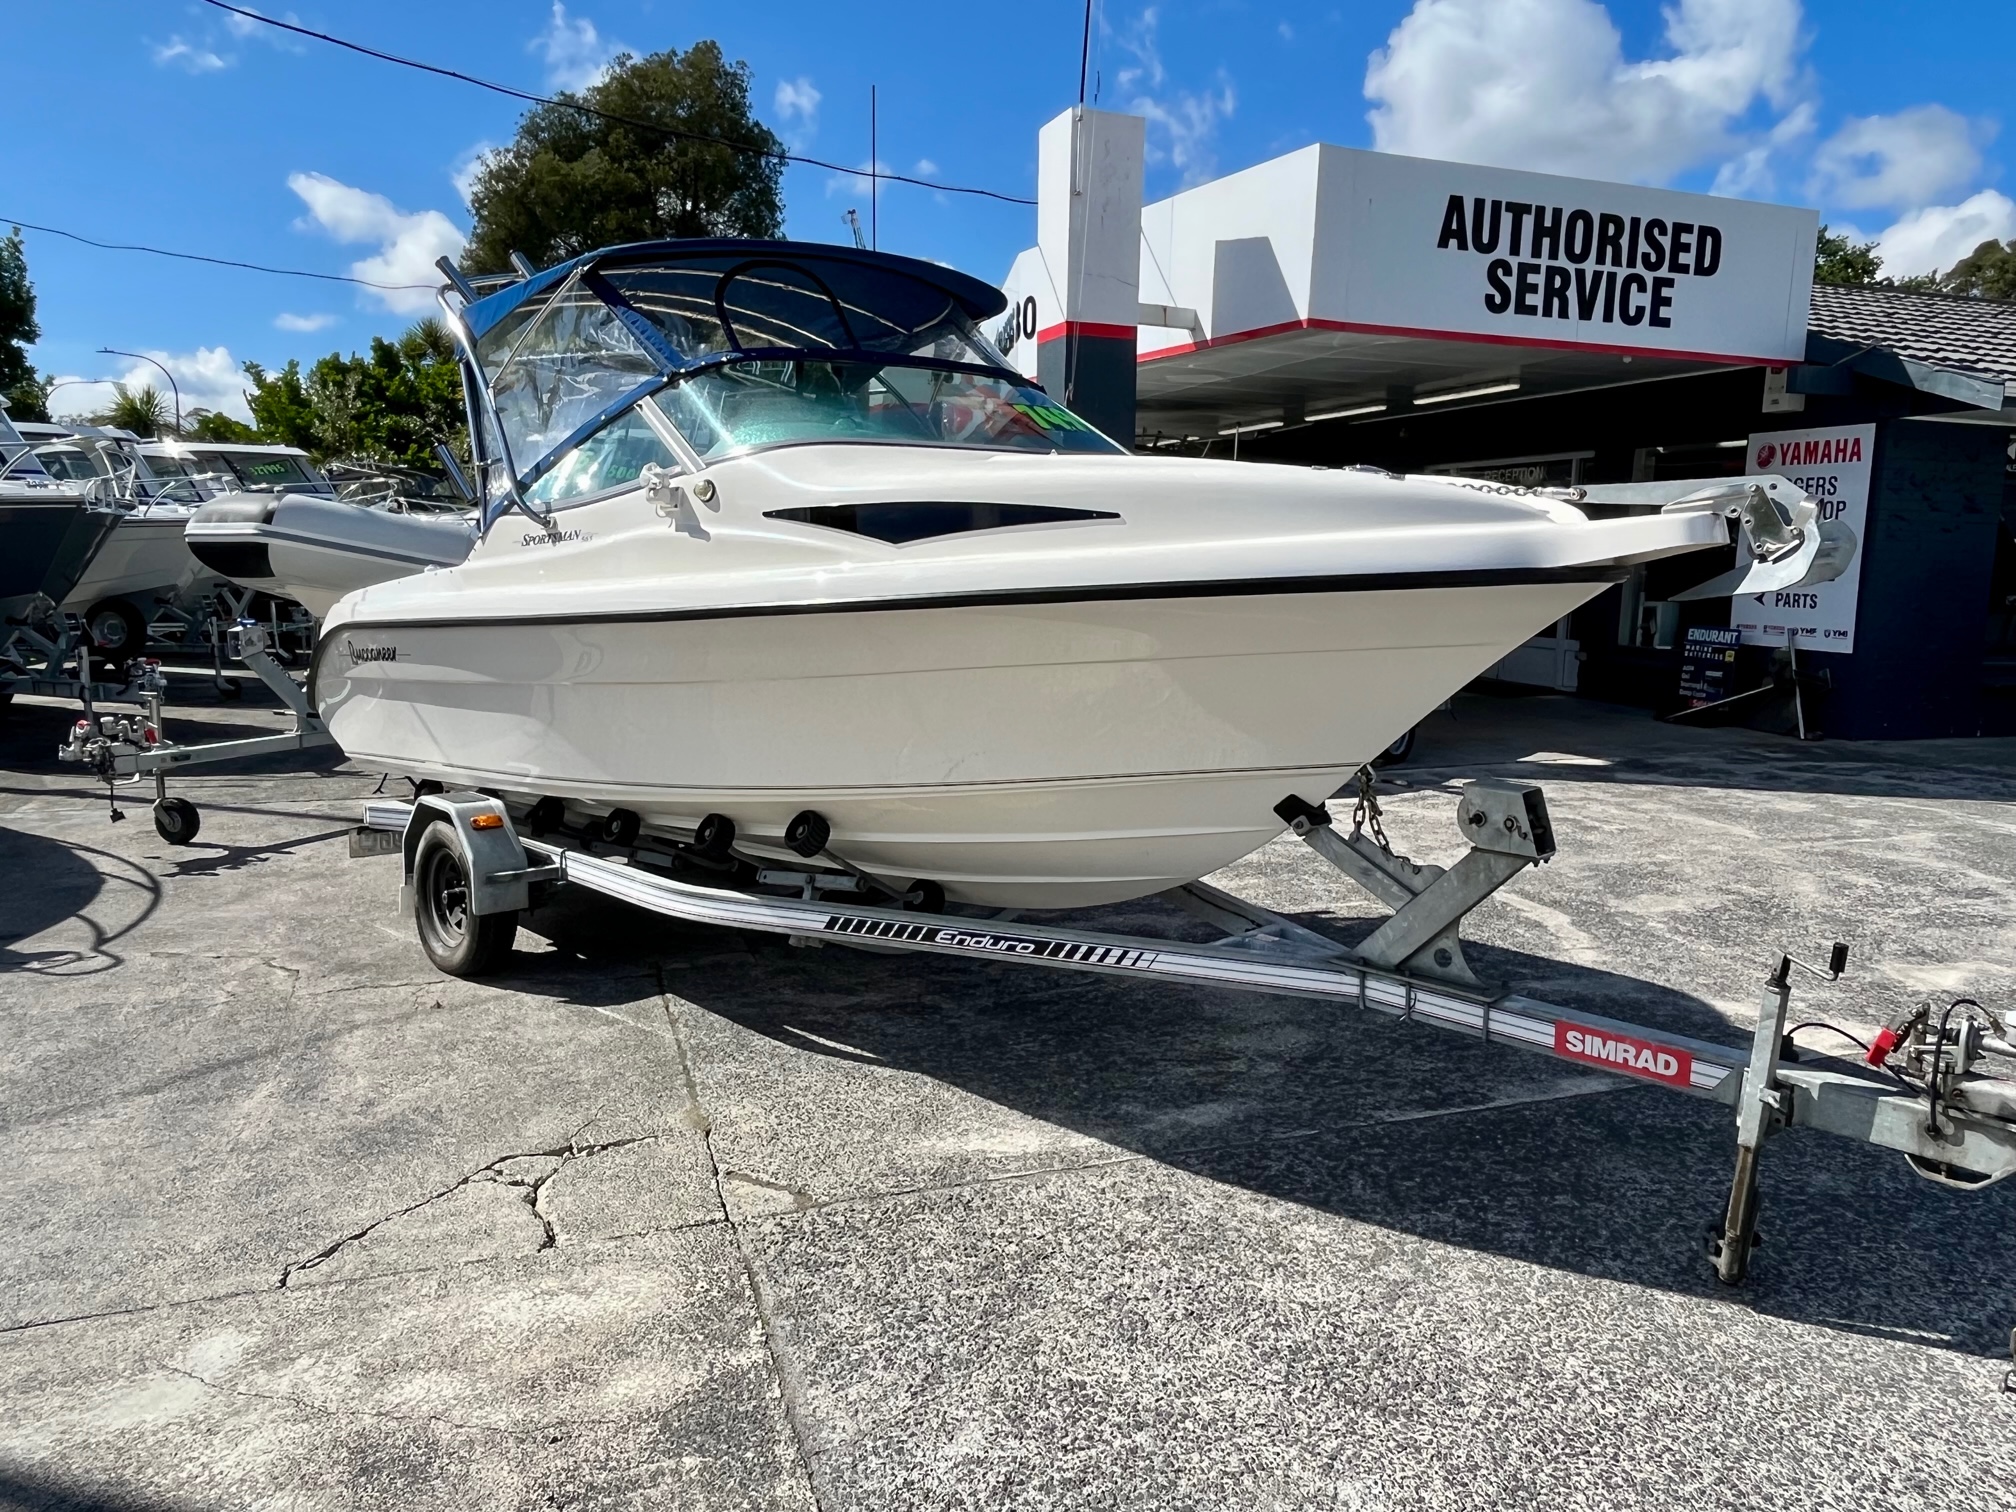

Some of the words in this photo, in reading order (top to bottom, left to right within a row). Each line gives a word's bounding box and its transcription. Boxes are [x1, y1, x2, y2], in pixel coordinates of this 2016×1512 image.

[1437, 194, 1722, 276] AUTHORISED
[1484, 258, 1676, 328] SERVICE
[1780, 437, 1862, 466] YAMAHA
[1484, 466, 1545, 481] RECEPTION
[1775, 592, 1818, 609] PARTS
[1687, 628, 1739, 644] ENDURANT
[934, 930, 1035, 953] Enduro
[1565, 1030, 1679, 1076] SIMRAD
